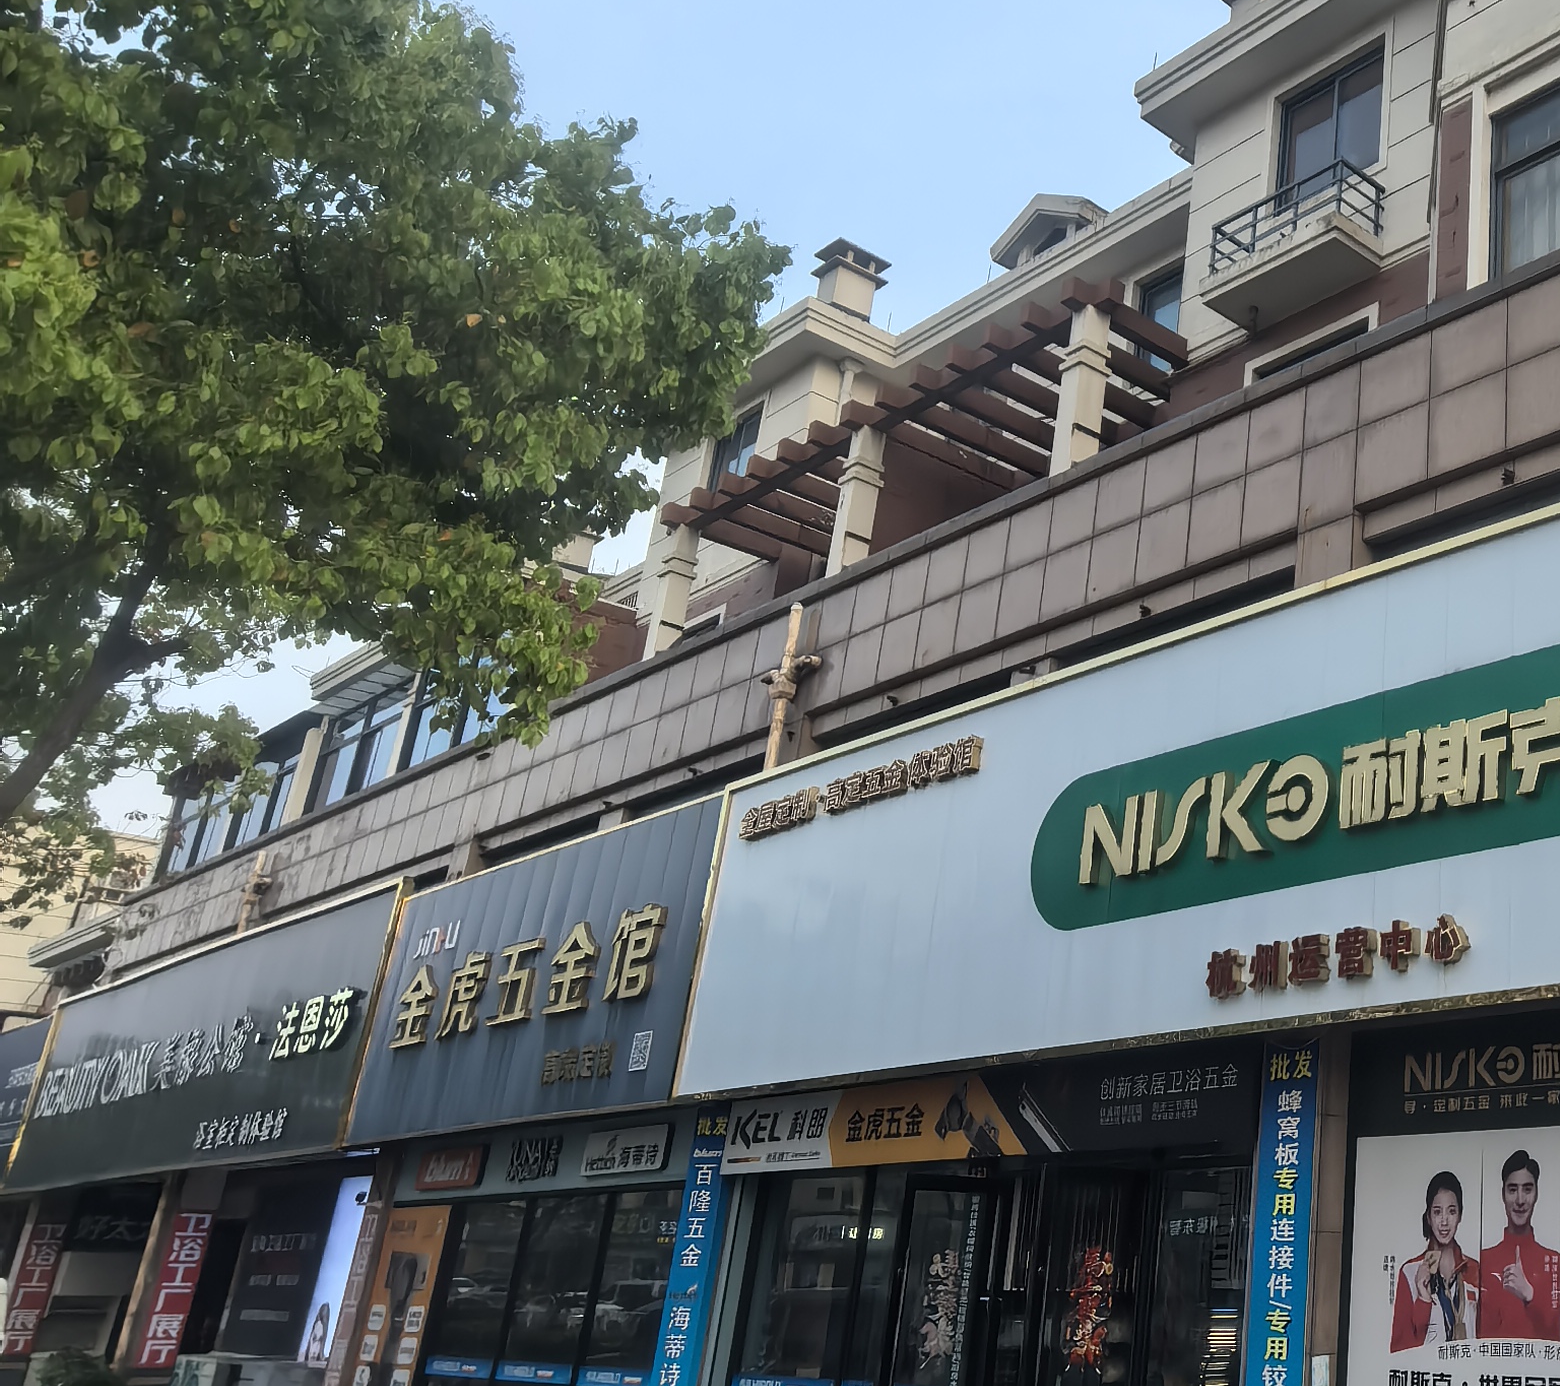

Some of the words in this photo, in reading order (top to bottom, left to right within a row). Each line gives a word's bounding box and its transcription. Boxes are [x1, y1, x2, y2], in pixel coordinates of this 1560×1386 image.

[389, 902, 668, 1050] 金虎五金馆
[1205, 913, 1472, 1000] 杭州运营中心
[269, 986, 354, 1061] 法恩莎
[1100, 1063, 1239, 1101] 创新家居卫浴五金
[730, 1108, 783, 1150] KEL
[845, 1103, 925, 1144] 金虎五金
[74, 1214, 152, 1242] 好太
[679, 1163, 719, 1268] 百隆五金
[138, 1213, 213, 1365] 卫浴工厂展厅
